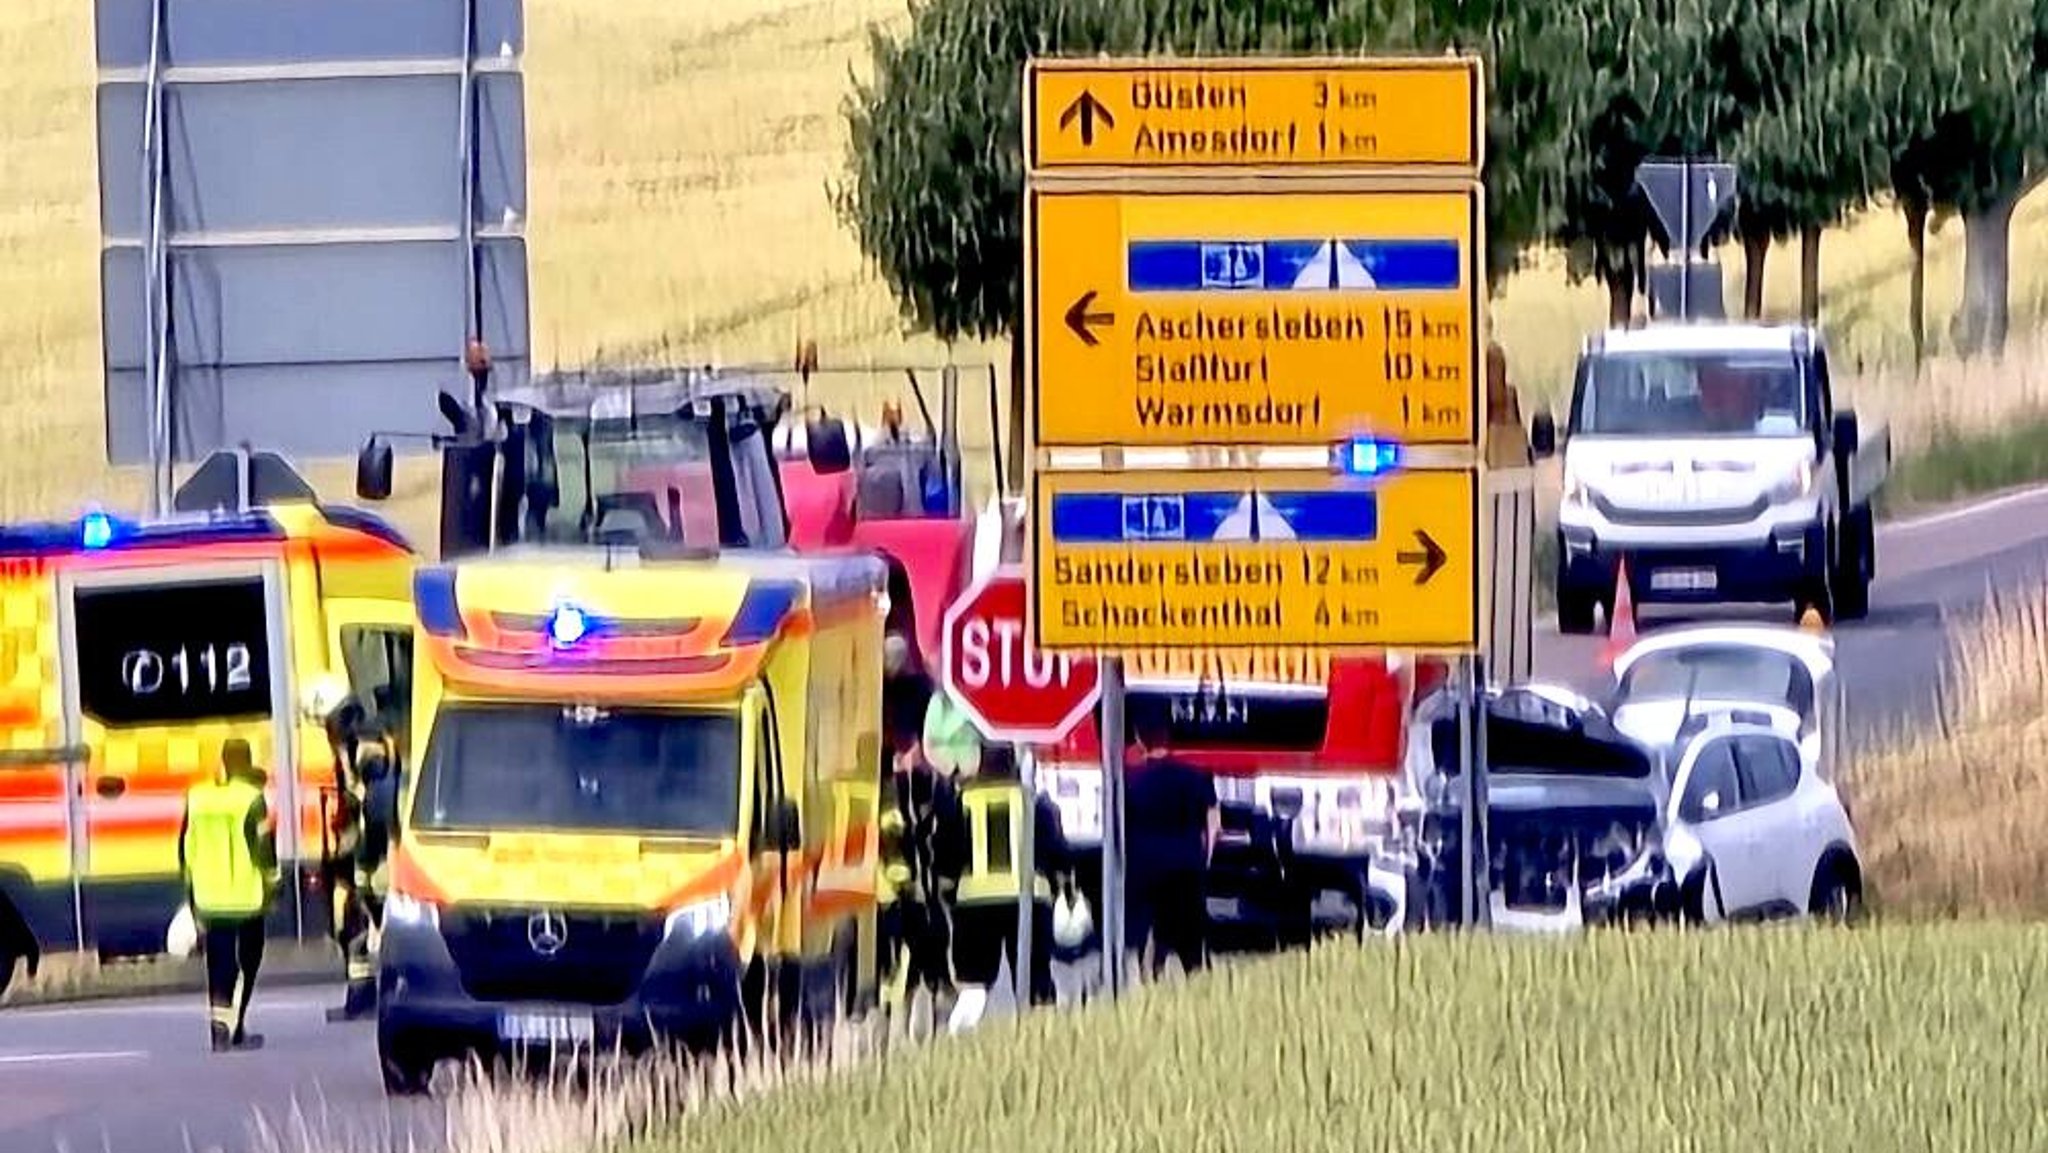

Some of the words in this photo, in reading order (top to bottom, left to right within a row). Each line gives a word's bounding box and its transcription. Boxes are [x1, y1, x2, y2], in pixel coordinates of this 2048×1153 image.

[1314, 81, 1329, 110] 3
[1339, 88, 1377, 108] km
[1318, 121, 1327, 154] 1
[1339, 131, 1377, 152] km
[1135, 307, 1364, 342] Aschersleben
[1384, 306, 1412, 341] 15
[1421, 317, 1460, 337] km
[1384, 352, 1413, 382] 10
[1422, 361, 1460, 380] km
[1135, 397, 1320, 427] Warmsdorf
[1402, 397, 1410, 426] 1
[1422, 403, 1460, 423] km
[1054, 552, 1283, 586] Sandersleben
[1302, 551, 1331, 585] 12
[1341, 563, 1379, 583] km
[1061, 597, 1283, 628] Schackenthal
[1313, 599, 1331, 627] 4
[1341, 605, 1379, 625] km
[171, 642, 251, 695] 112
